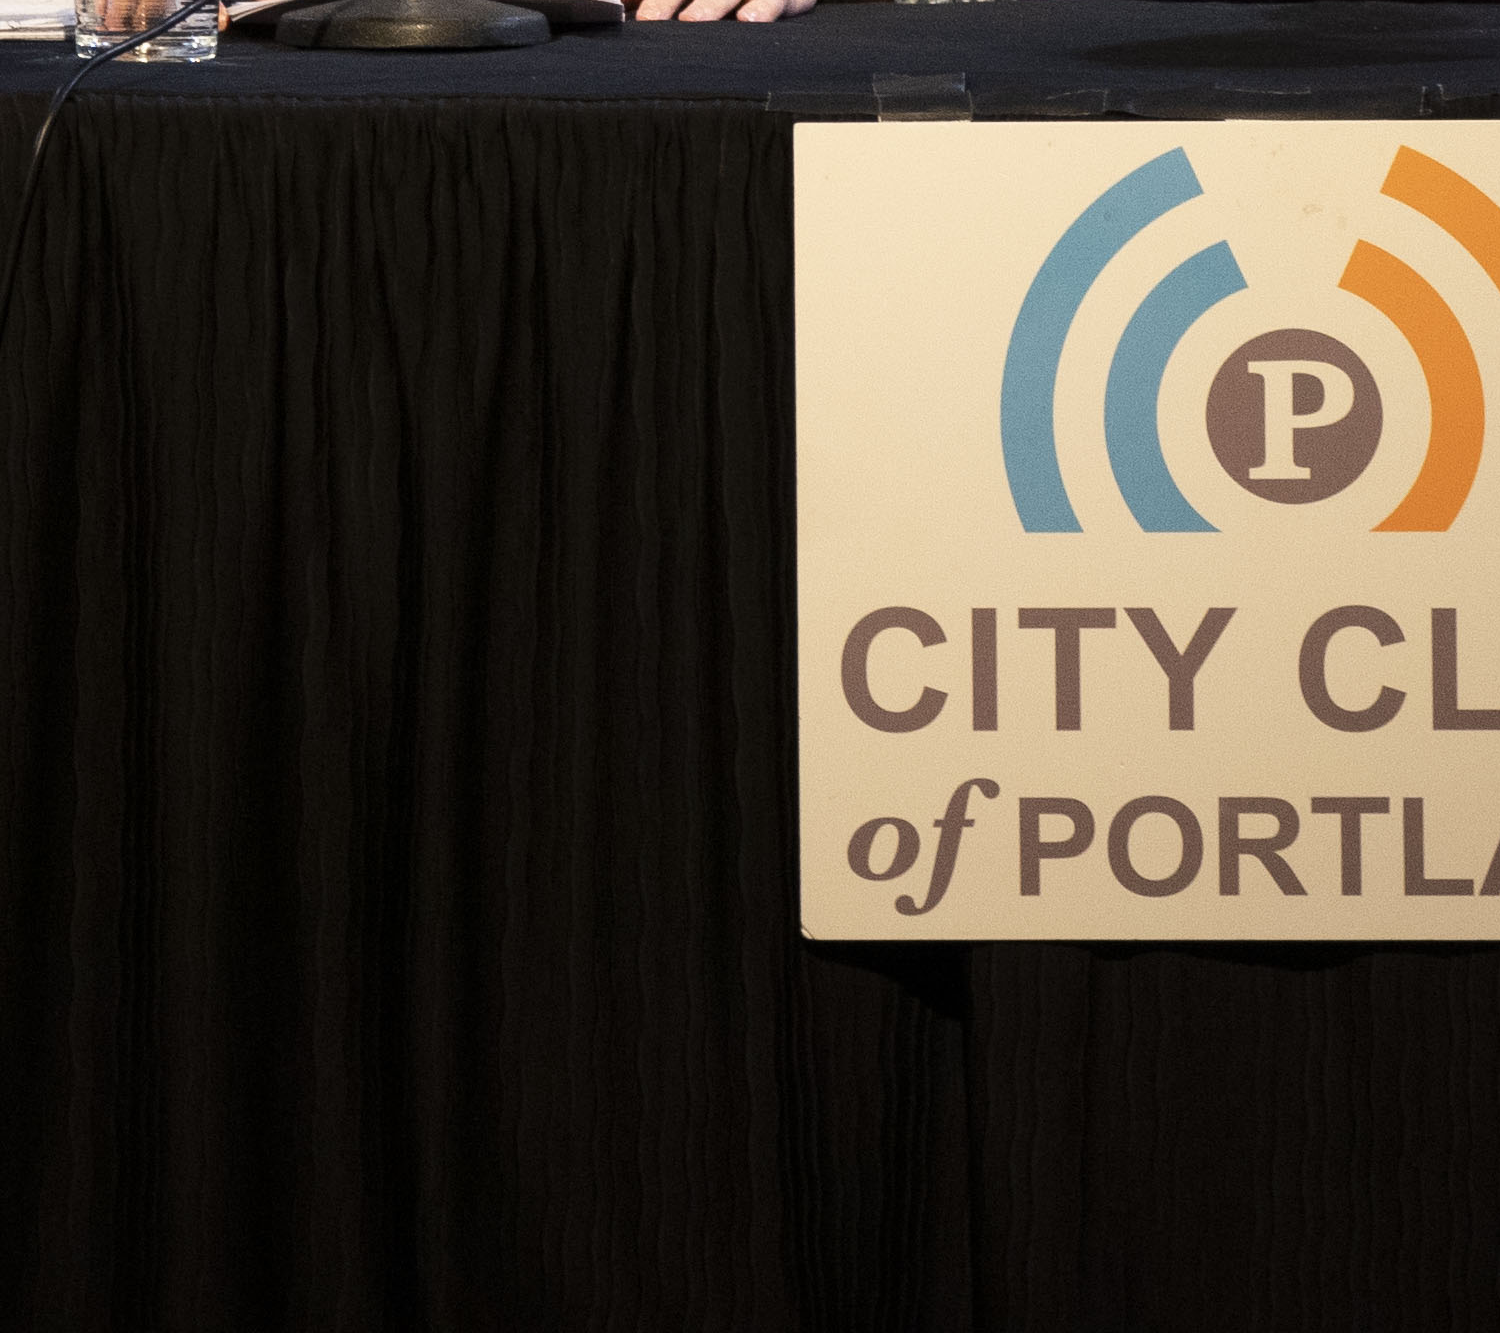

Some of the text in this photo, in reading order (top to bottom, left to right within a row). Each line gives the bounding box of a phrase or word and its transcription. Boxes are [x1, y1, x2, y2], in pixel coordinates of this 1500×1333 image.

[1246, 359, 1355, 481] P
[840, 605, 1238, 733] CITY
[846, 777, 1000, 917] of
